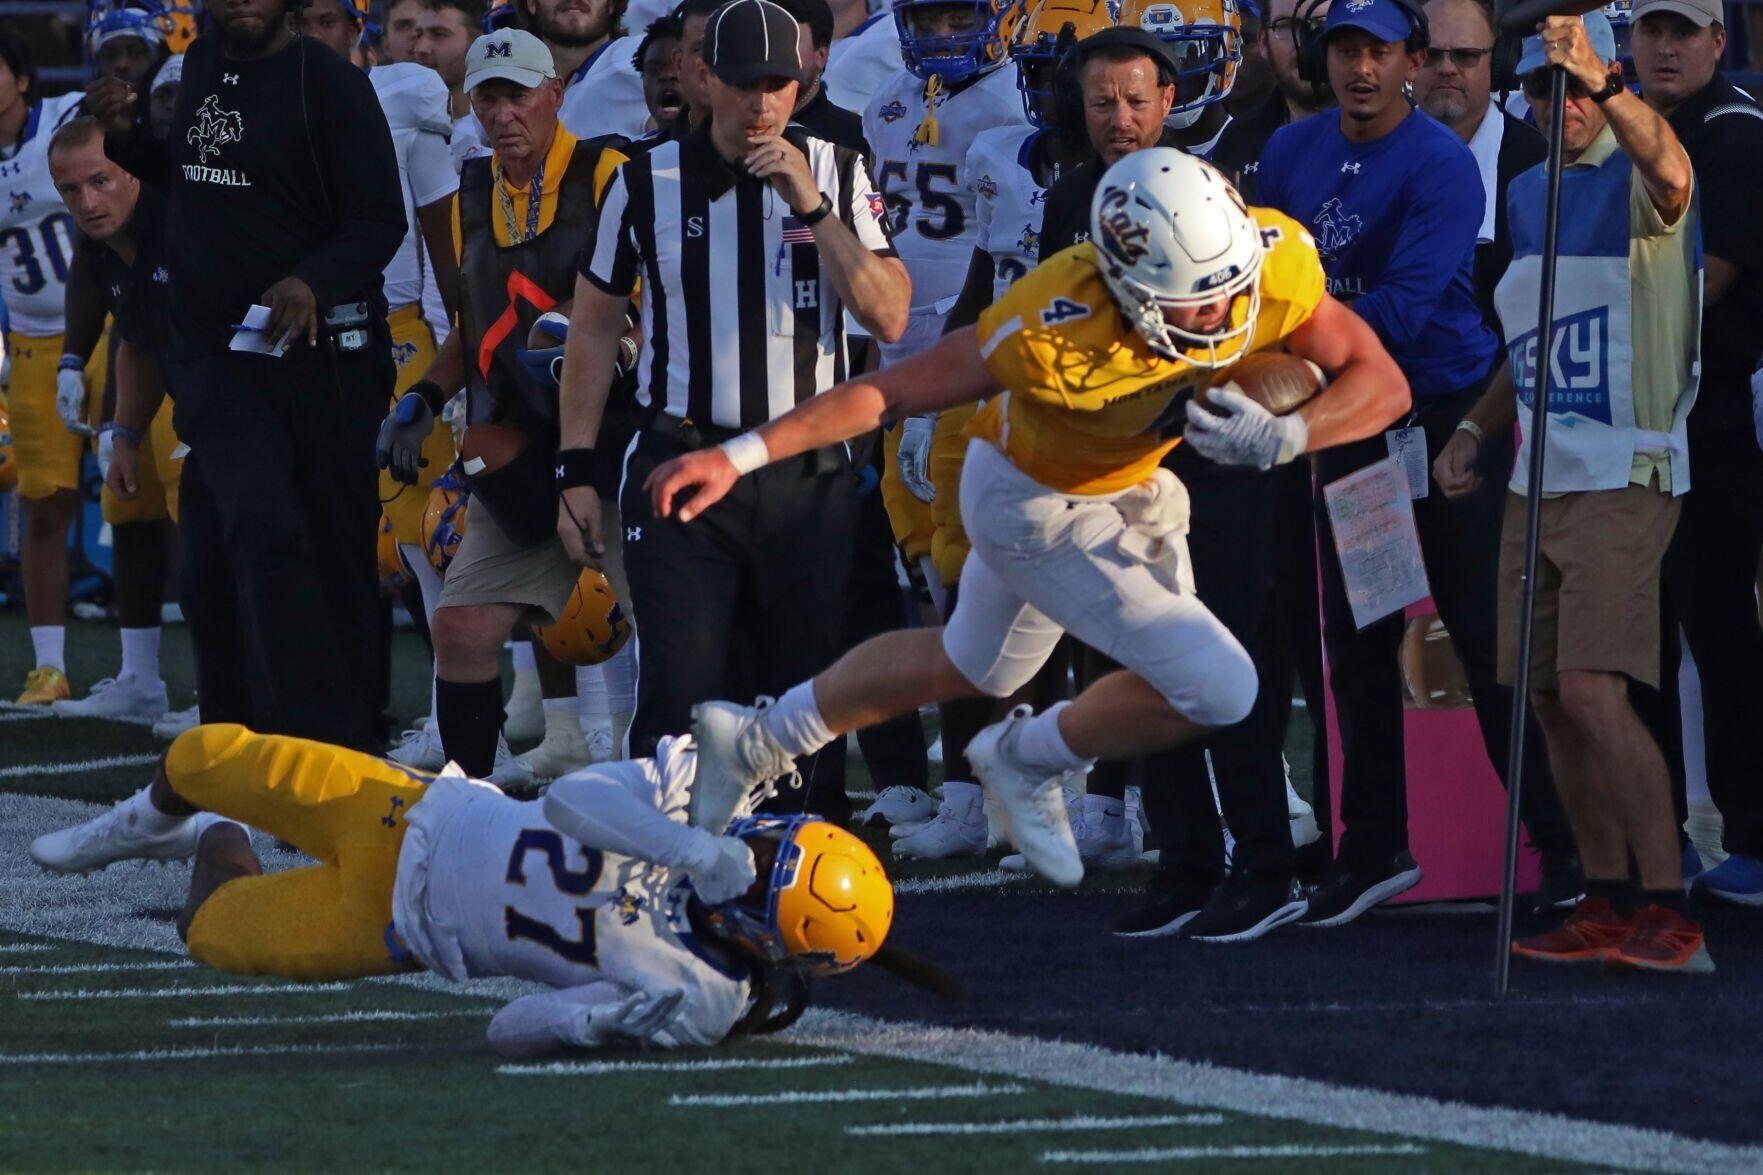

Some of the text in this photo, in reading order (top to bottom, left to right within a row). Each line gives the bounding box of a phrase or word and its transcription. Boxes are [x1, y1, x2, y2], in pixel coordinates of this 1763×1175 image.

[485, 42, 512, 59] M
[687, 216, 704, 238] S
[0, 212, 76, 296] 30
[1208, 269, 1232, 286] 406
[795, 279, 817, 309] H
[1042, 298, 1089, 324] 4
[1524, 392, 1603, 404] COERENCE
[506, 829, 603, 969] 27
